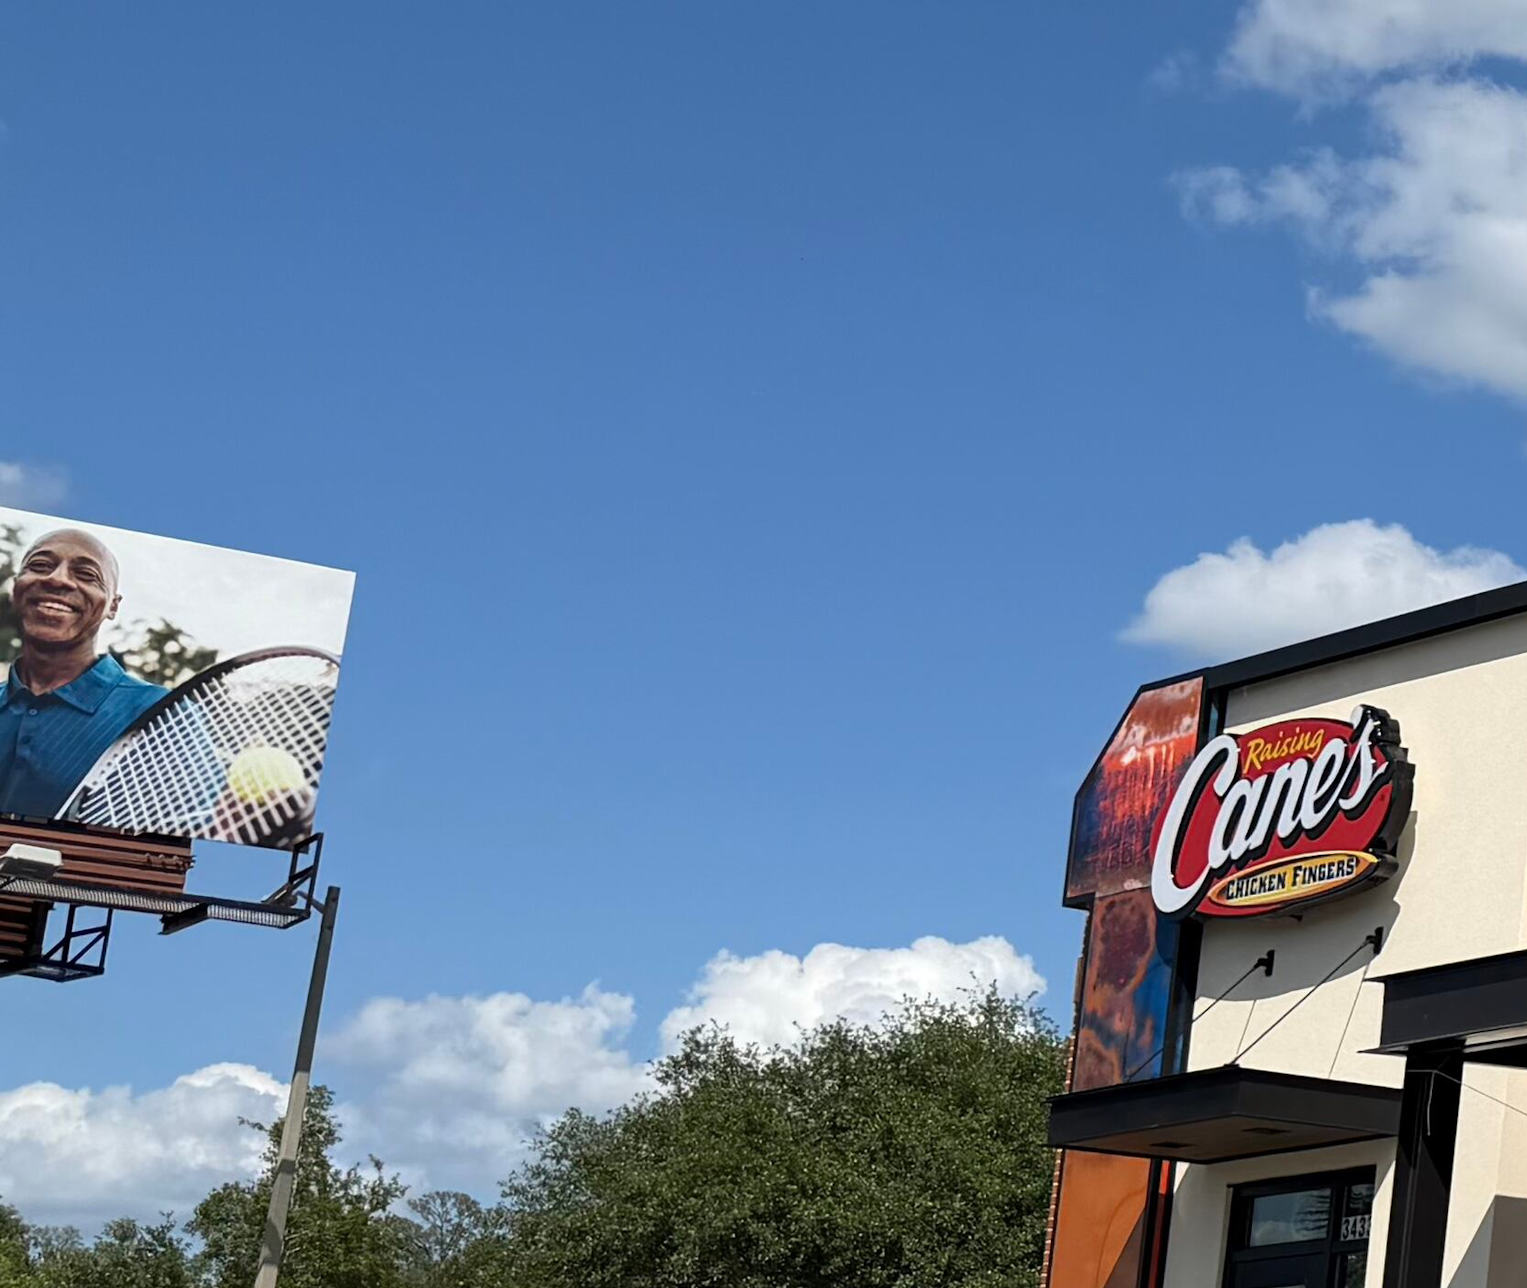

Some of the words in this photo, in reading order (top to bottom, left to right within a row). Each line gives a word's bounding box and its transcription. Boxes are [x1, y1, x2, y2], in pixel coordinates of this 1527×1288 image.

[1242, 726, 1325, 775] Raising
[1151, 704, 1389, 914] Cane's
[1226, 870, 1288, 900] CHICKEN
[1292, 856, 1357, 887] FINGERS
